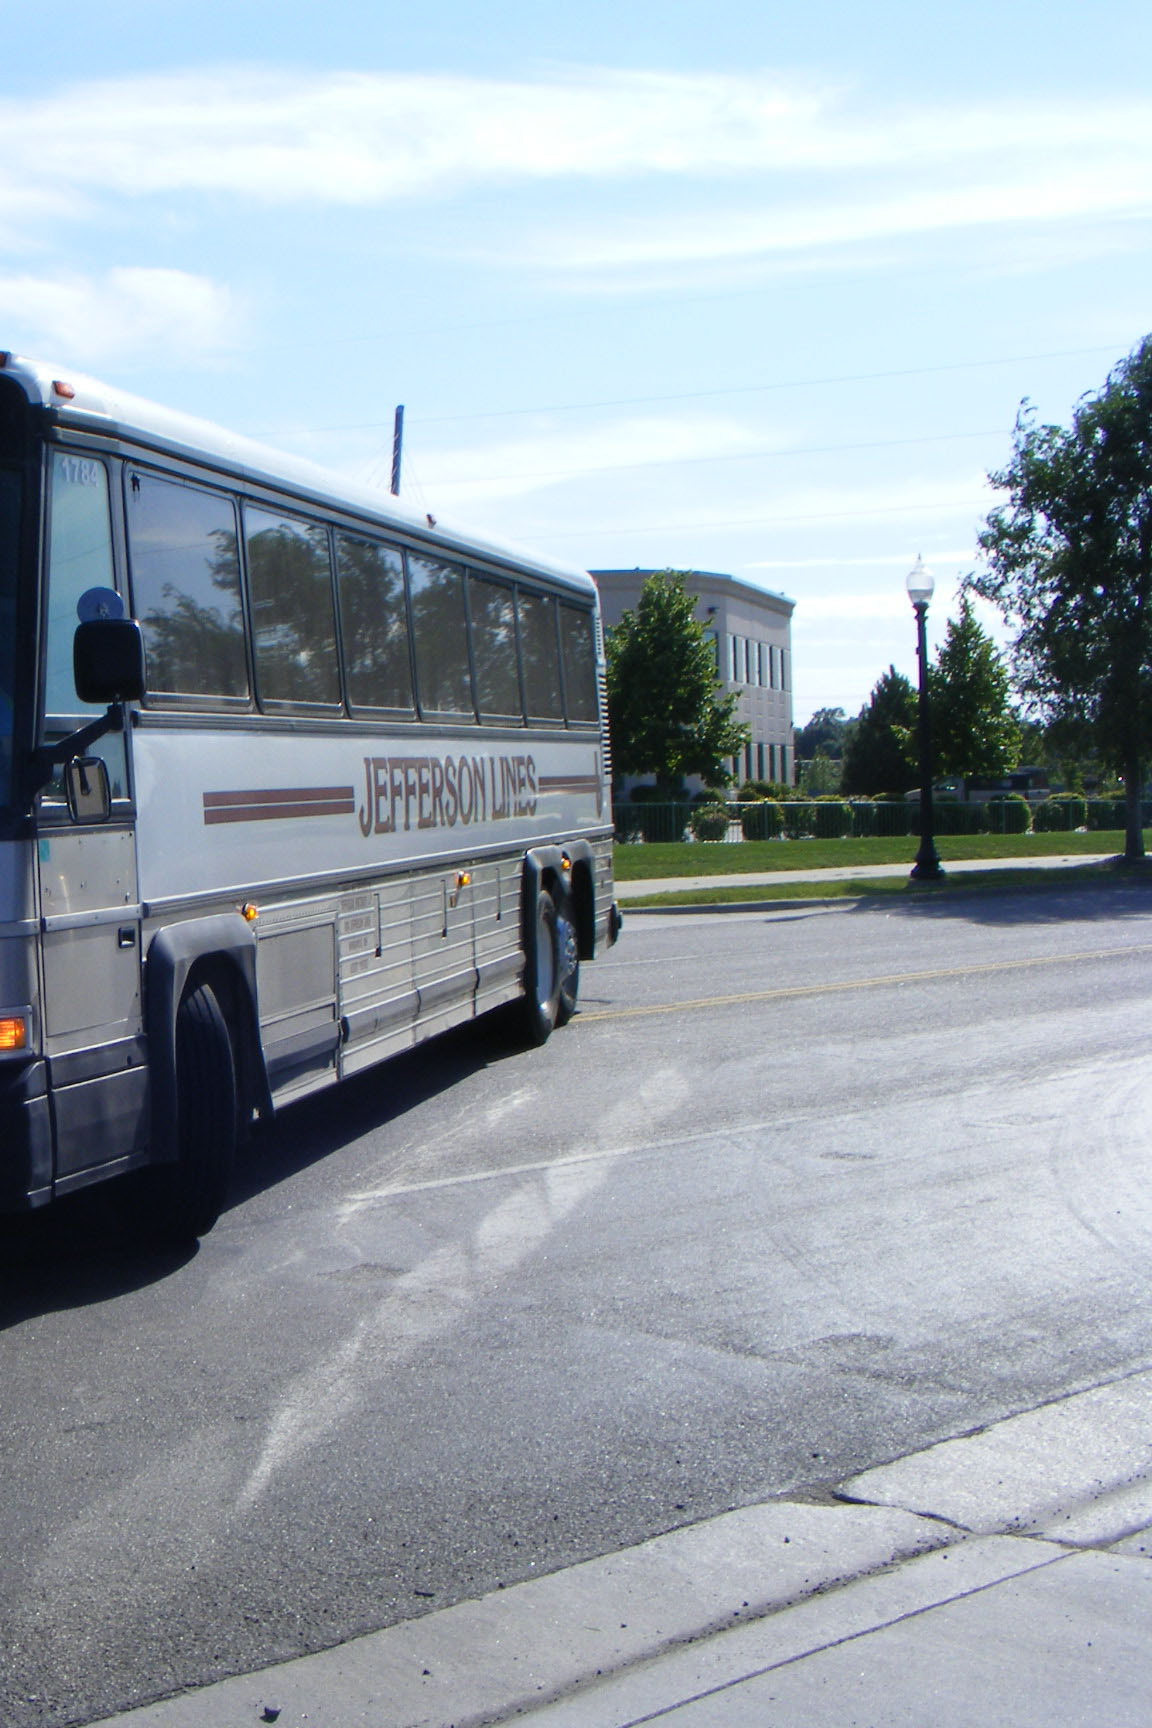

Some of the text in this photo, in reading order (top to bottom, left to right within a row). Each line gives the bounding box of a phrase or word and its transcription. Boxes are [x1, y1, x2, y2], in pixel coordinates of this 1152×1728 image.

[62, 458, 98, 487] 1784
[359, 755, 537, 838] JEFFERSON LINES
